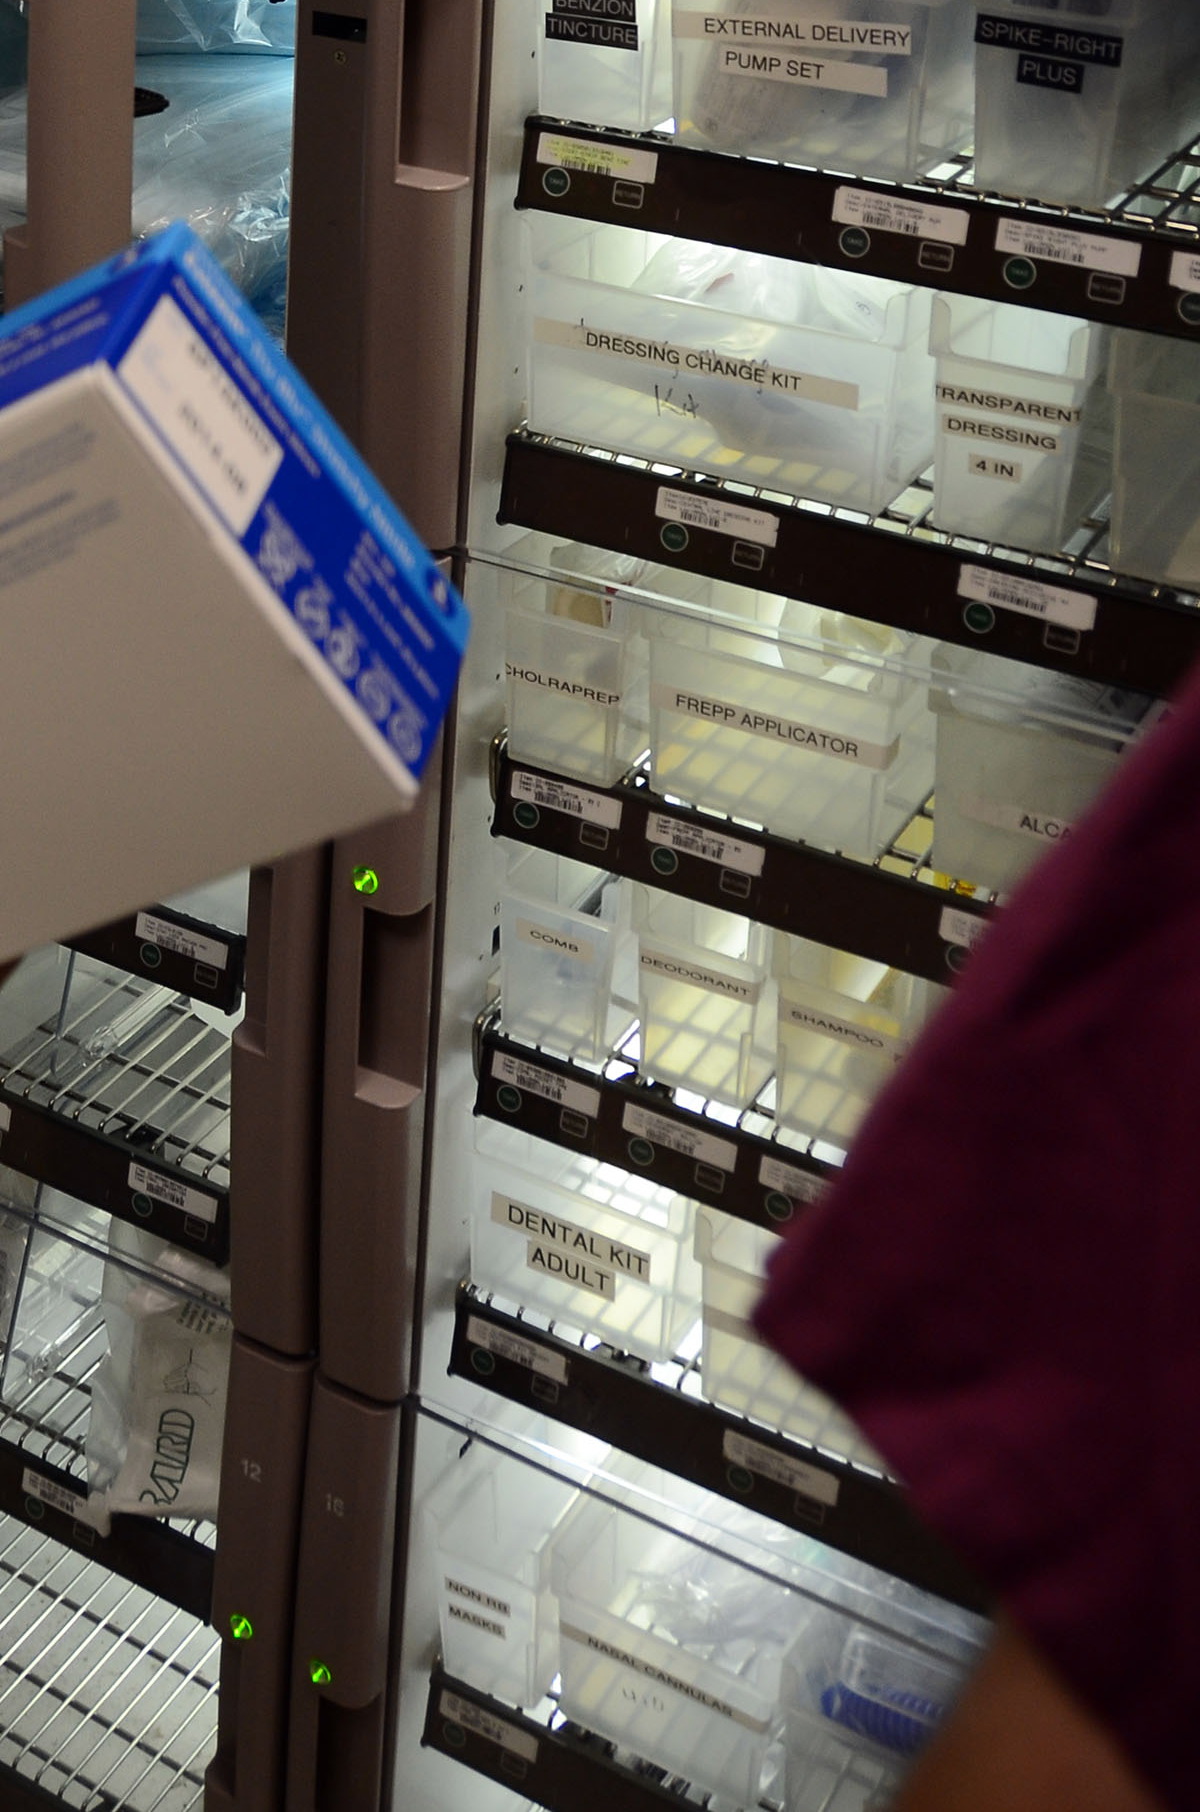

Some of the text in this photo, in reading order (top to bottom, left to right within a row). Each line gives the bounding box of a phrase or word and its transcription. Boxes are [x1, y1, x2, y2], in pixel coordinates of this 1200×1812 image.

[547, 17, 636, 45] TINCTURE
[704, 17, 911, 47] EXTERNAL DELIVERY
[980, 20, 1121, 59] SPIKE-RIGHT
[725, 50, 825, 80] PUMP SET
[1022, 59, 1077, 86] PLUS
[585, 331, 802, 391] DRESSING CHANGE KIT
[935, 384, 1082, 423] TRANSPARENT
[947, 418, 1057, 451] DRESSING
[975, 459, 1015, 477] 4 IN
[675, 693, 859, 758] FREPP APPLICATOR
[529, 928, 580, 955] COMB
[640, 954, 751, 997] DEODORANT
[790, 1009, 885, 1049] SHAMPOO
[508, 1203, 649, 1276] DENTAL KIT
[530, 1246, 611, 1292] ADULT
[241, 1458, 262, 1484] 12
[644, 1664, 733, 1718] CANNULAS
